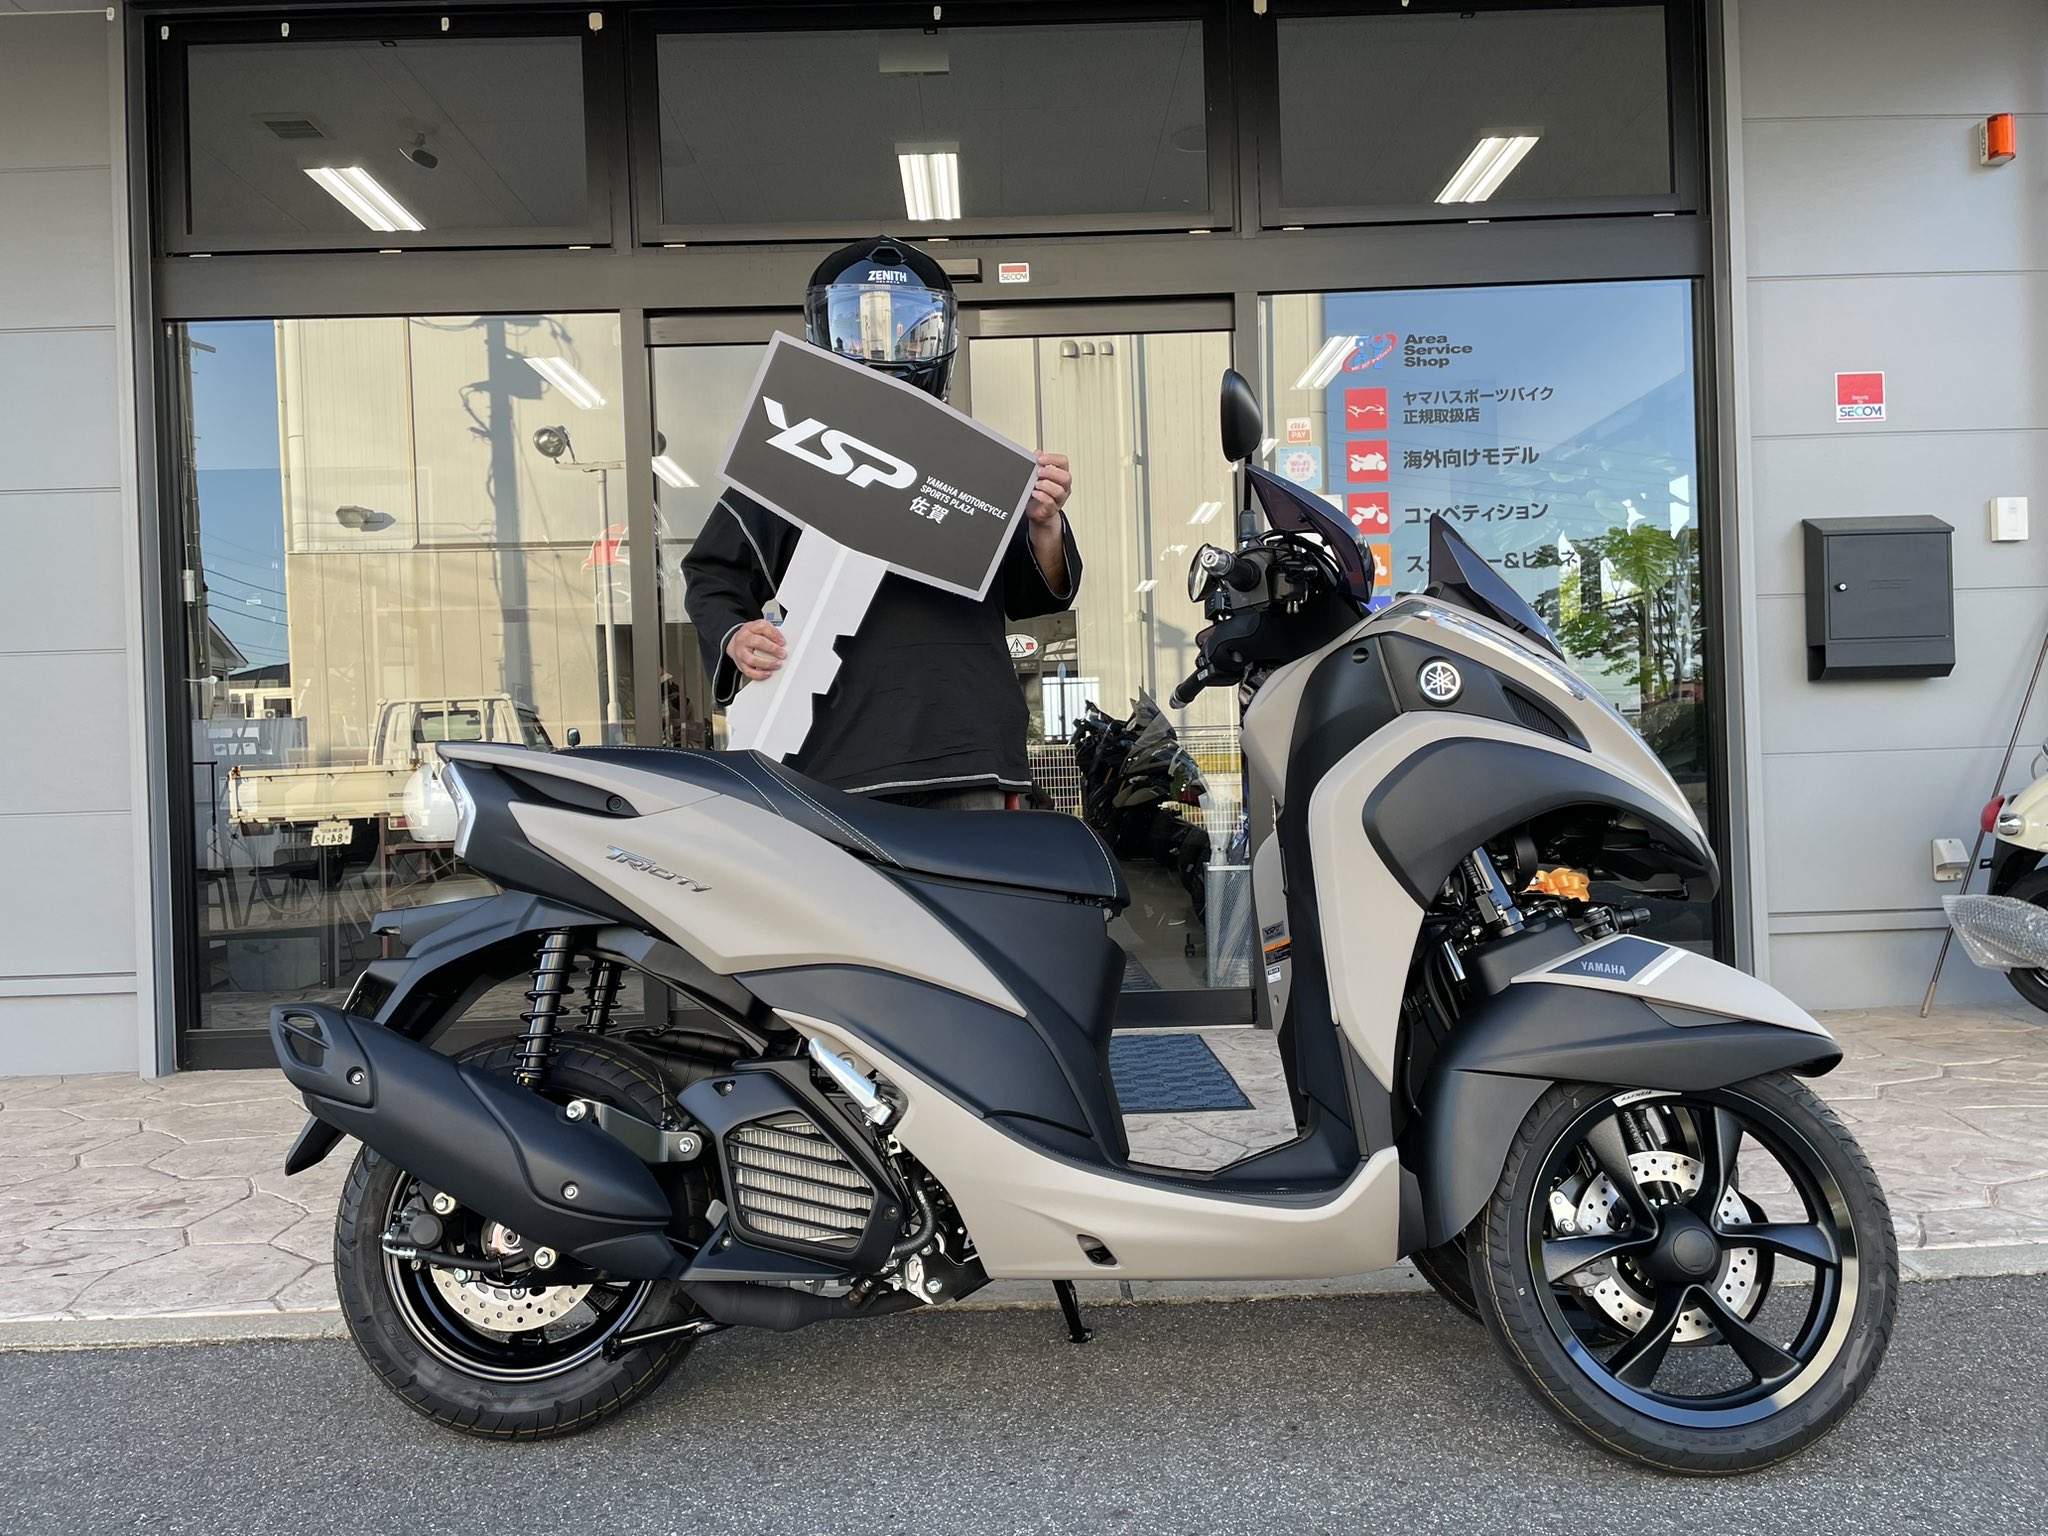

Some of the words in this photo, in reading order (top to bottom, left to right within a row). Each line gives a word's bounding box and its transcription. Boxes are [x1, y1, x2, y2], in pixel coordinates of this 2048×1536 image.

[867, 269, 907, 283] ZENITH
[1001, 273, 1028, 281] SECOM
[1404, 334, 1448, 344] Area
[1404, 344, 1473, 356] Service
[1404, 356, 1450, 369] Shop
[1403, 386, 1554, 406] ヤマハスポーツバイク
[1403, 407, 1480, 425] 正規取扱店
[1840, 406, 1882, 417] SECOM
[762, 395, 918, 489] YSP
[1291, 430, 1307, 438] PAY
[1403, 446, 1540, 469] 海外向けモデル
[920, 484, 950, 504] SPORTS
[949, 498, 975, 516] PLAZA
[926, 475, 958, 497] YAMAHA
[957, 491, 1008, 520] MOTORCYCLE
[909, 496, 949, 524] 佐賀
[1405, 503, 1549, 524] コンペティション
[605, 844, 713, 893] TRICITY
[1580, 961, 1626, 976] YAMAHA
